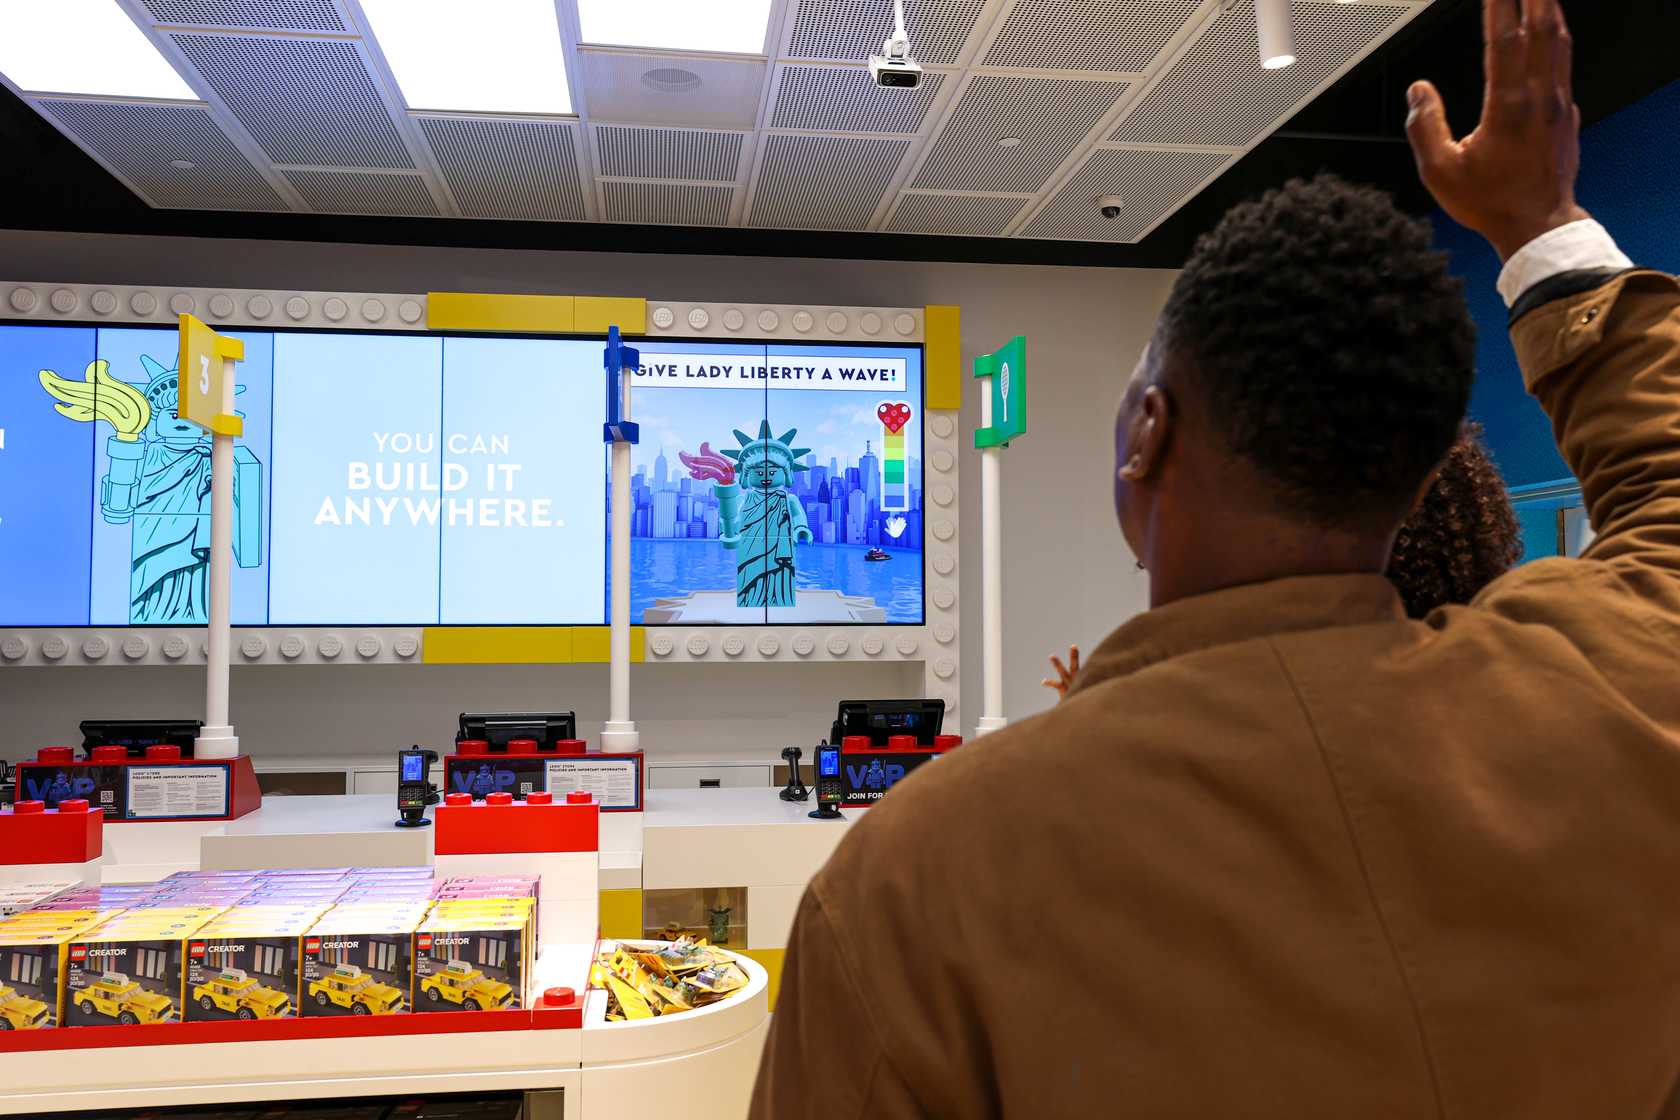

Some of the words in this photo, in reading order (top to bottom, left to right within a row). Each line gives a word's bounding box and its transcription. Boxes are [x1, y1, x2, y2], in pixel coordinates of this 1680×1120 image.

[199, 351, 209, 395] 3
[686, 364, 733, 378] LADY
[740, 365, 816, 380] LIBERTY
[821, 367, 833, 380] A
[838, 368, 896, 381] WAVE!
[373, 431, 434, 454] YOU
[448, 433, 509, 455] CAN
[348, 461, 469, 491] BUILD
[487, 463, 522, 492] IT
[313, 496, 565, 527] ANYWHERE.
[847, 792, 866, 800] JOIN
[323, 941, 359, 949] CREATOR
[434, 937, 470, 945] CREATOR
[88, 948, 127, 957] CREATOR
[208, 945, 245, 953] CREATOR
